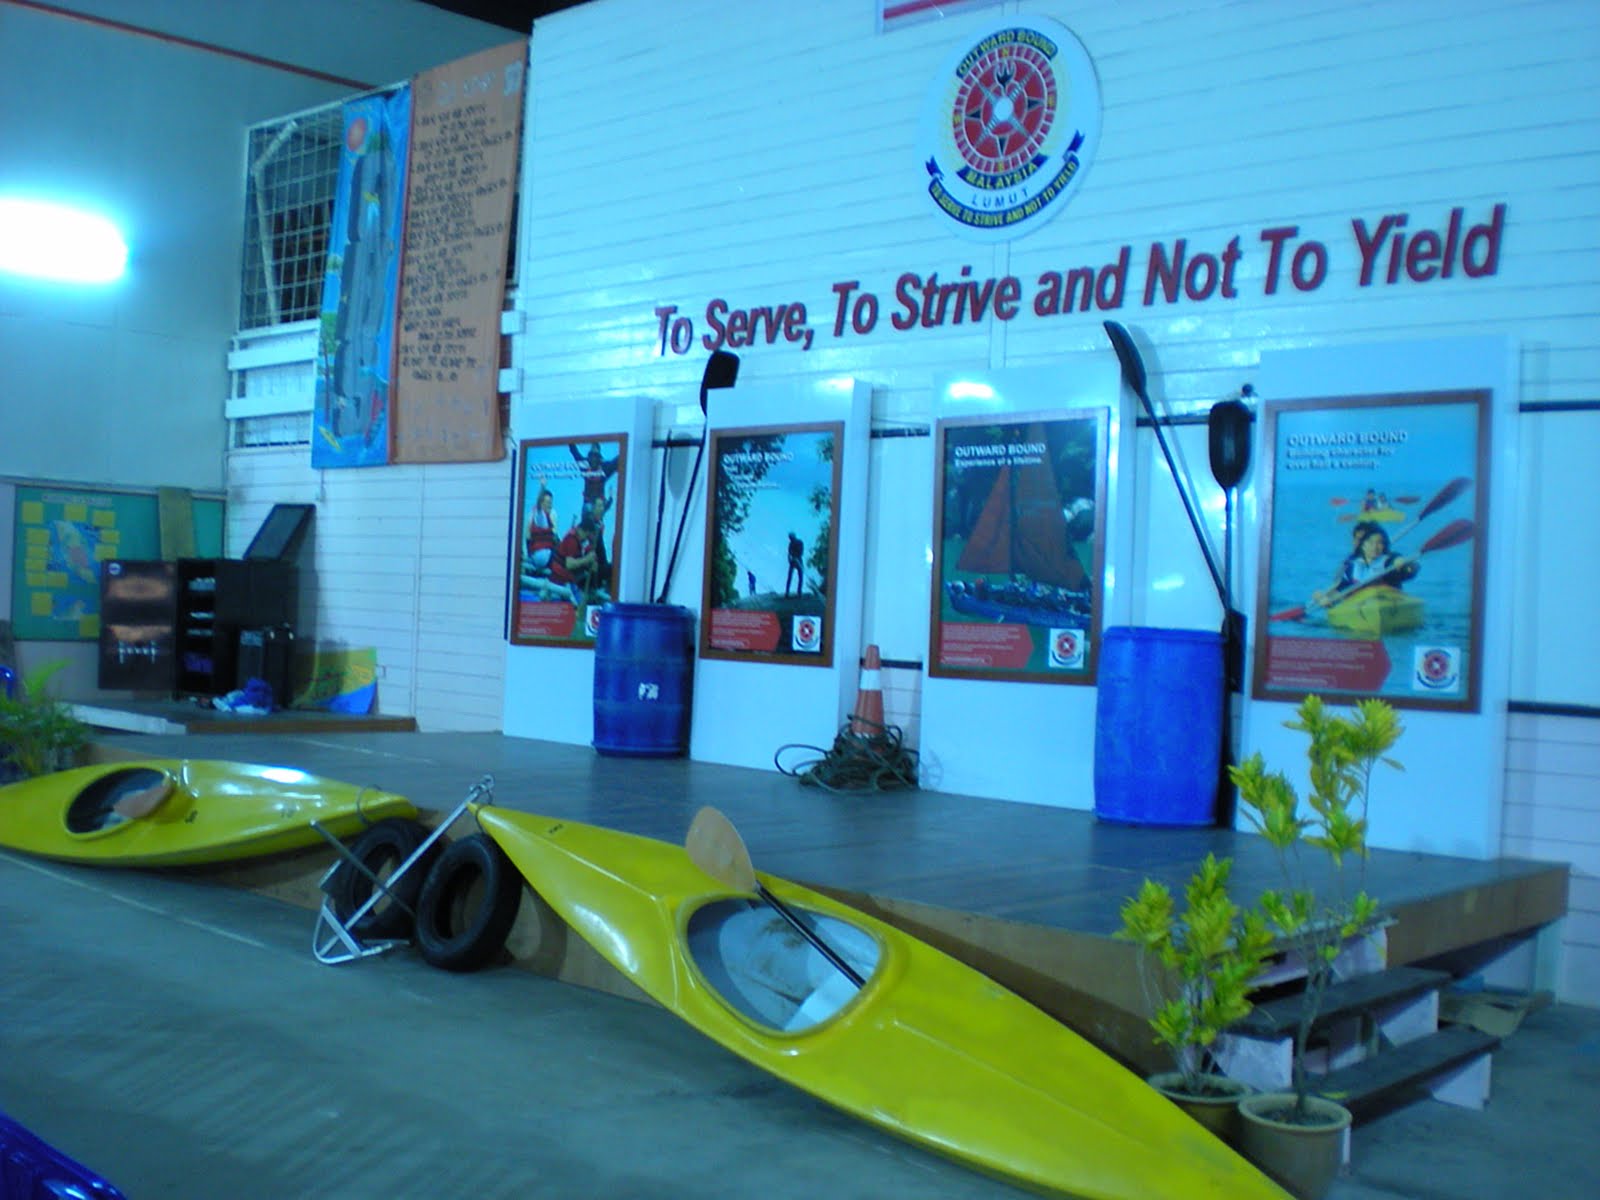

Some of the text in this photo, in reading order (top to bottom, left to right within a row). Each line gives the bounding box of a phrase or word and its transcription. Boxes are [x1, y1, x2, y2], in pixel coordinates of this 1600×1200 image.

[971, 188, 1028, 208] LUMUT
[654, 203, 1507, 356] To Serve, To Strive and Not To Yield
